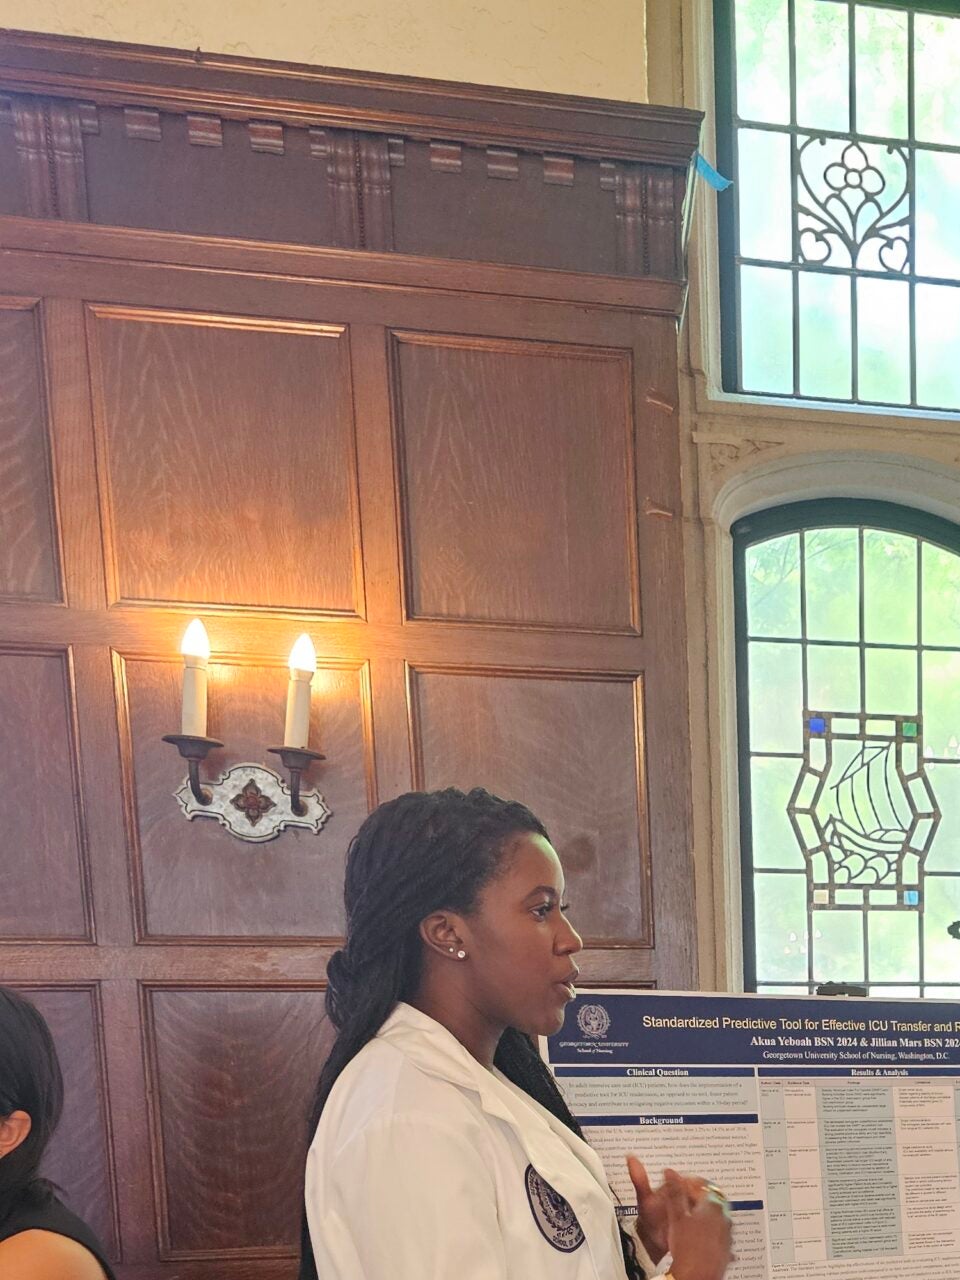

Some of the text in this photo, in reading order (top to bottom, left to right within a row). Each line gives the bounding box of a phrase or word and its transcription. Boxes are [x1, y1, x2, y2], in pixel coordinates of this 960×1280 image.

[642, 1015, 720, 1029] Standardized
[722, 1017, 777, 1030] Predictive
[779, 1018, 802, 1030] Tool
[804, 1019, 820, 1031] for
[822, 1019, 867, 1031] Effective
[868, 1020, 889, 1031] ICU
[890, 1020, 932, 1032] Transfer
[934, 1022, 952, 1033] and
[750, 1036, 776, 1046] Akua
[777, 1036, 812, 1047] Yeboah
[814, 1037, 836, 1047] BSN
[836, 1037, 858, 1047] 2024
[859, 1038, 869, 1047] &
[870, 1037, 898, 1048] Jillian
[899, 1038, 923, 1048] Mars
[923, 1038, 943, 1048] BSN
[762, 1050, 804, 1061] Georgetown
[804, 1051, 838, 1061] University
[839, 1051, 861, 1060] School
[862, 1051, 871, 1060] of
[626, 1068, 690, 1077] Clinical Question
[639, 1116, 684, 1126] Background
